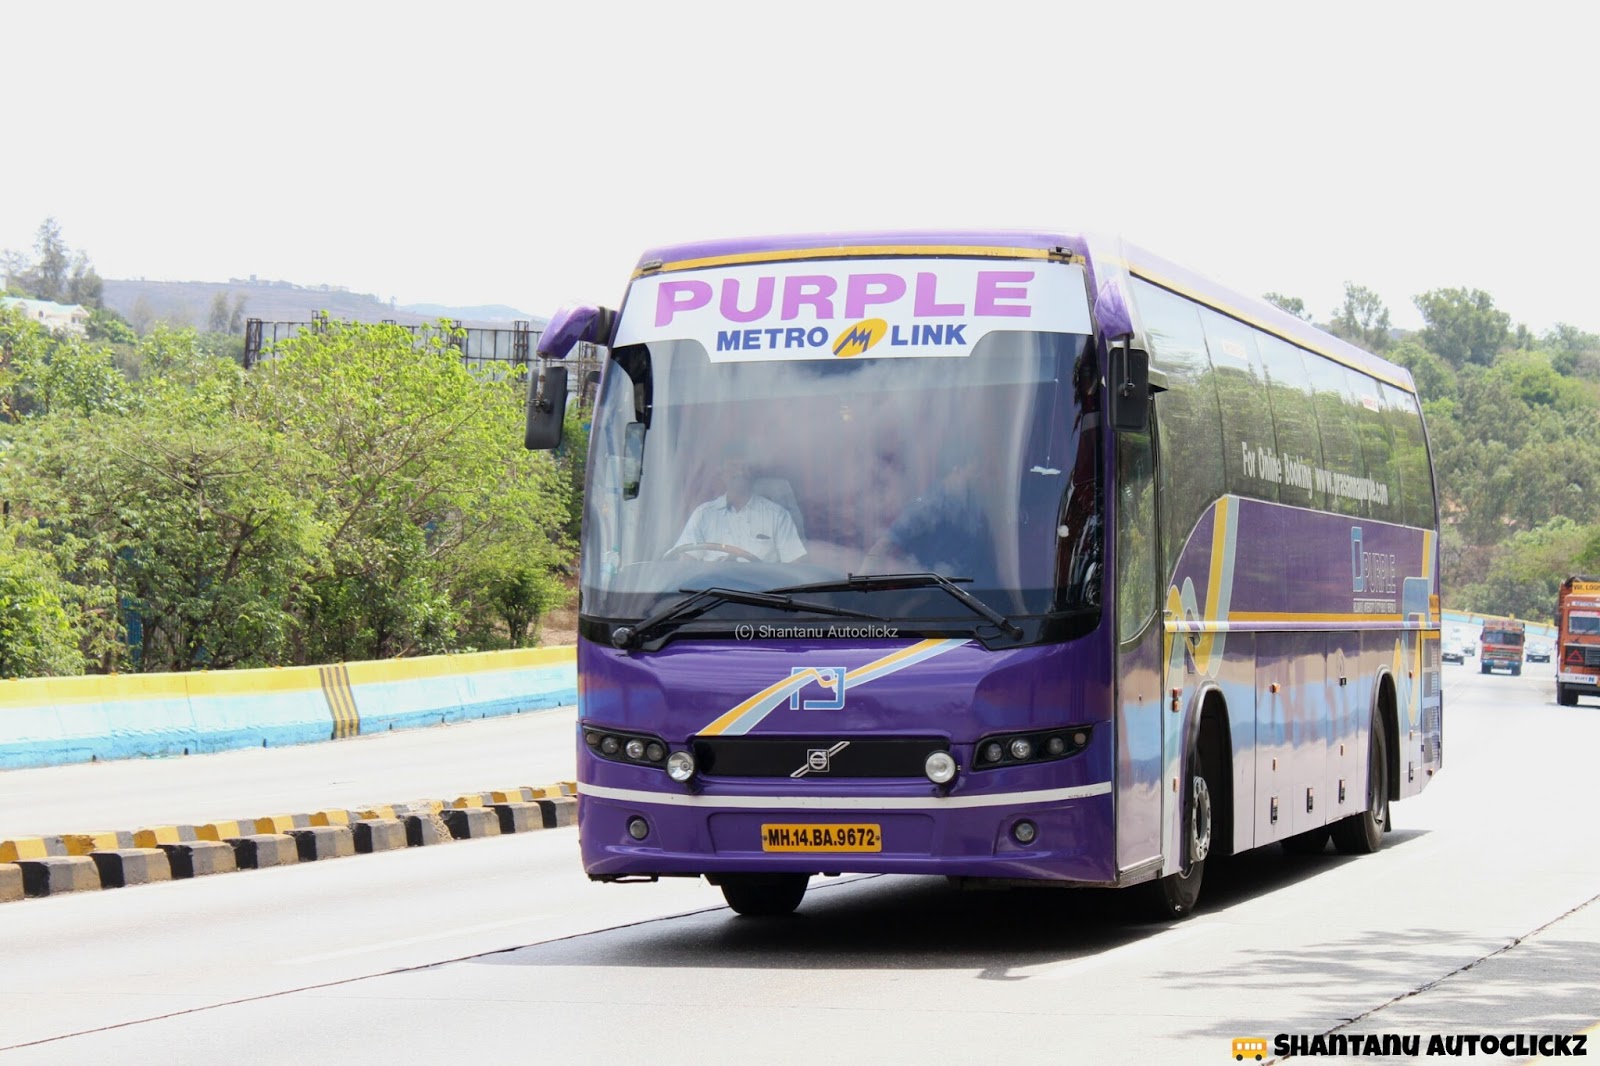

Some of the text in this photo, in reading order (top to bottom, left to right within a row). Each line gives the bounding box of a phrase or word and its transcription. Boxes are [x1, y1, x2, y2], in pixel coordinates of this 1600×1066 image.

[654, 271, 1036, 327] PURPLE
[716, 324, 968, 352] METRO LINK
[1241, 441, 1256, 478] For
[1258, 446, 1282, 484] Online
[1283, 452, 1313, 500] Booking
[1362, 551, 1396, 594] PURPLE
